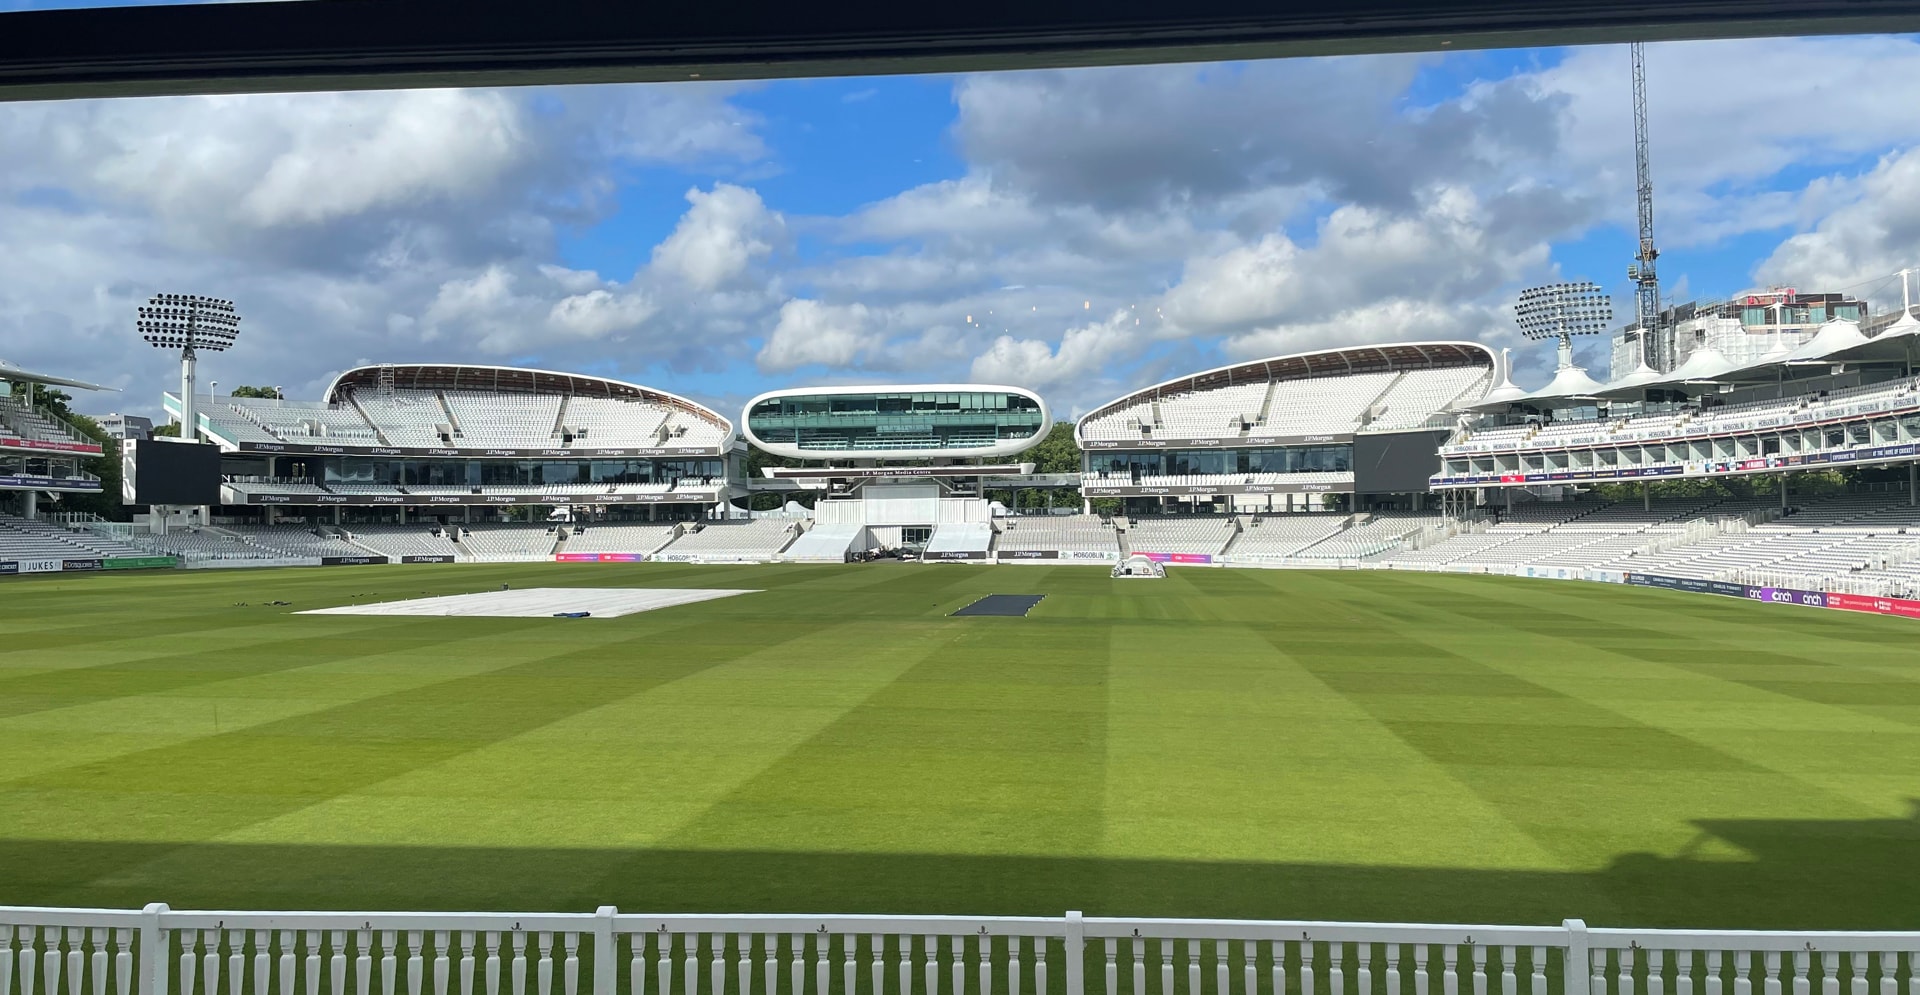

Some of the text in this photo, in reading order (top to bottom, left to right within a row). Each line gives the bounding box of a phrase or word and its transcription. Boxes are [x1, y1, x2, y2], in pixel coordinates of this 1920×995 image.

[28, 562, 53, 570] JUKES
[1750, 587, 1761, 598] cinc
[1772, 588, 1792, 602] cinch
[1803, 592, 1821, 605] cinch
